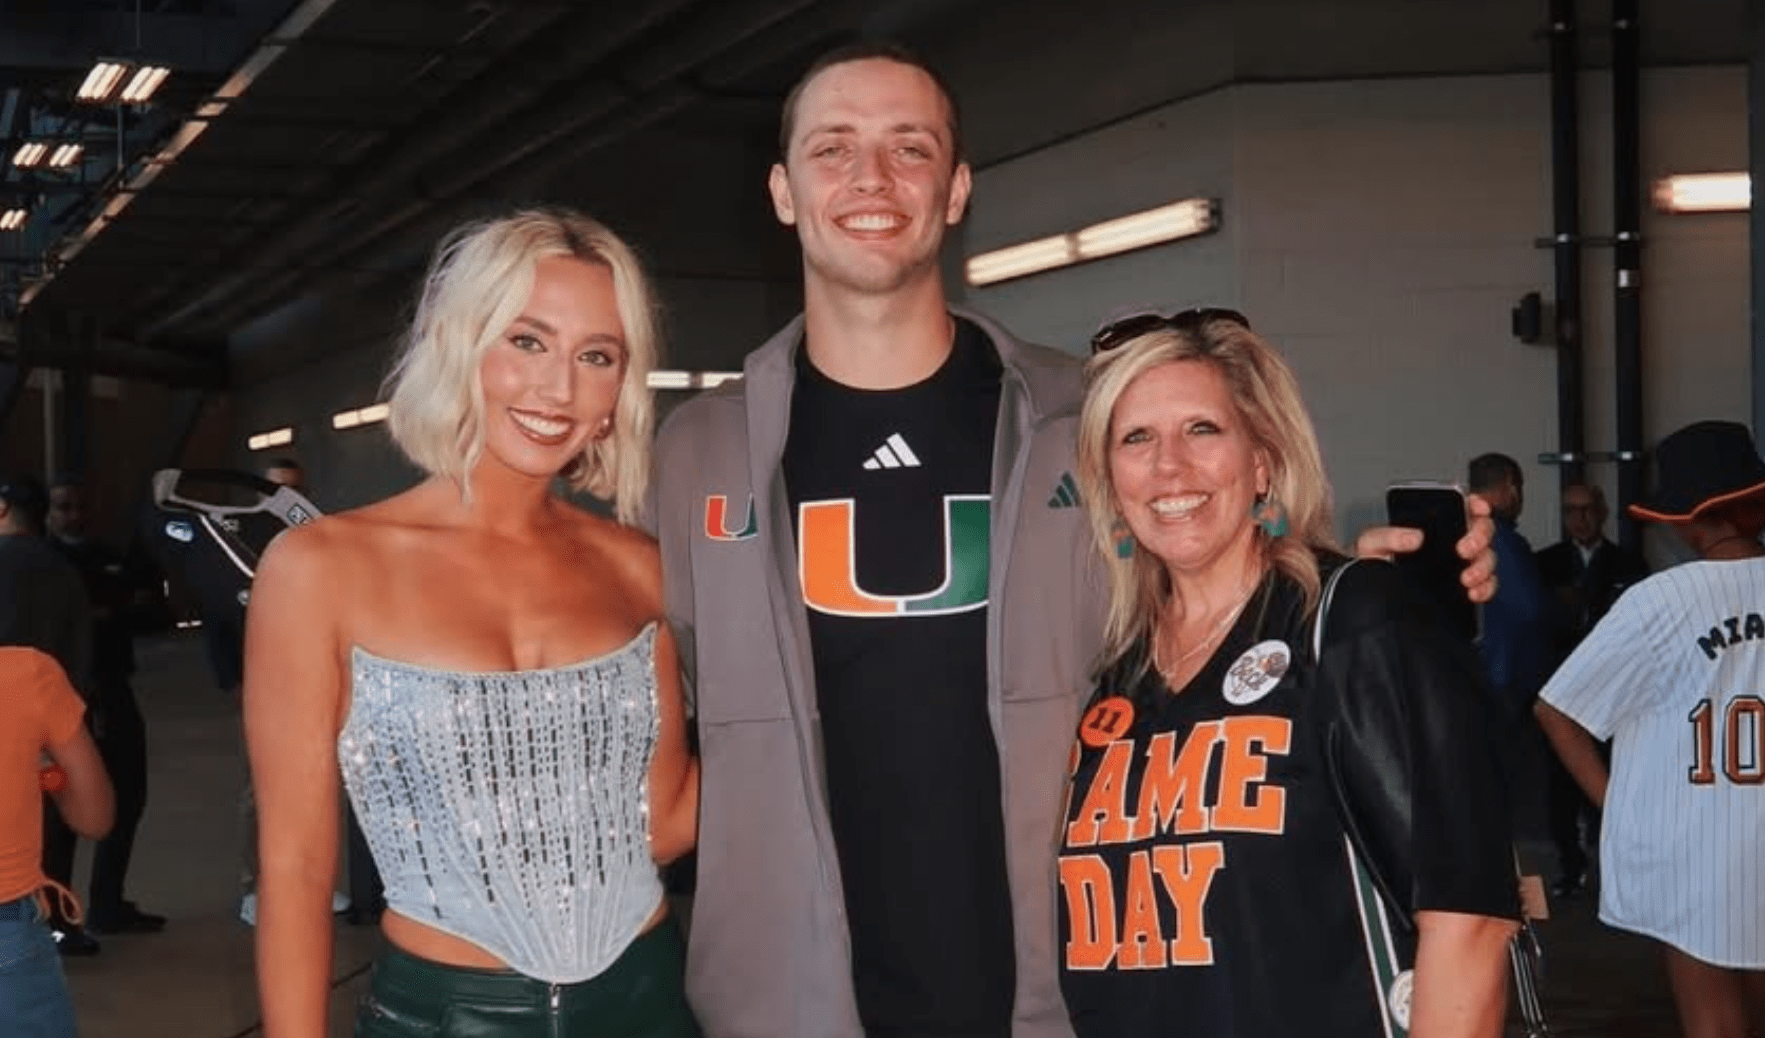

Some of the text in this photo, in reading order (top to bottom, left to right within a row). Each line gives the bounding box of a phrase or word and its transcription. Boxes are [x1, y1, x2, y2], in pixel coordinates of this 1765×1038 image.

[798, 494, 993, 618] U
[1697, 612, 1765, 660] MIA
[1087, 706, 1124, 735] 11
[1687, 694, 1765, 785] 10
[1062, 714, 1293, 847] AME
[1058, 841, 1226, 971] DAY
